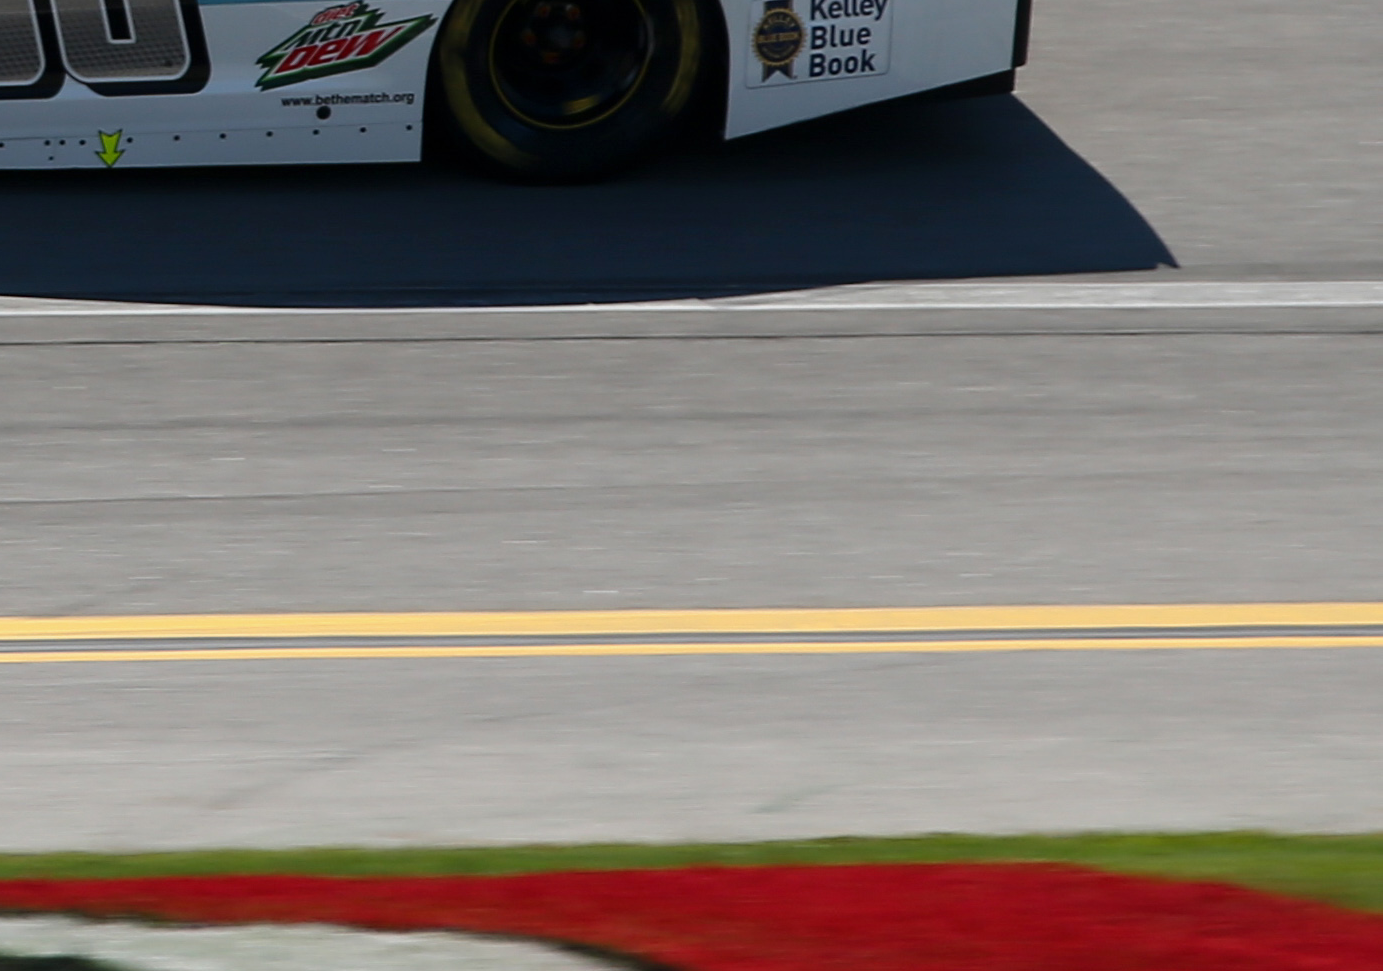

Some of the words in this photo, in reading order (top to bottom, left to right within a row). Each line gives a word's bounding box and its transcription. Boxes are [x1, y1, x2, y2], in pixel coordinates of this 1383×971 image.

[313, 3, 358, 24] diet
[810, 24, 871, 49] Blue
[809, 49, 876, 77] Book
[281, 92, 415, 107] www.bethematch.org
